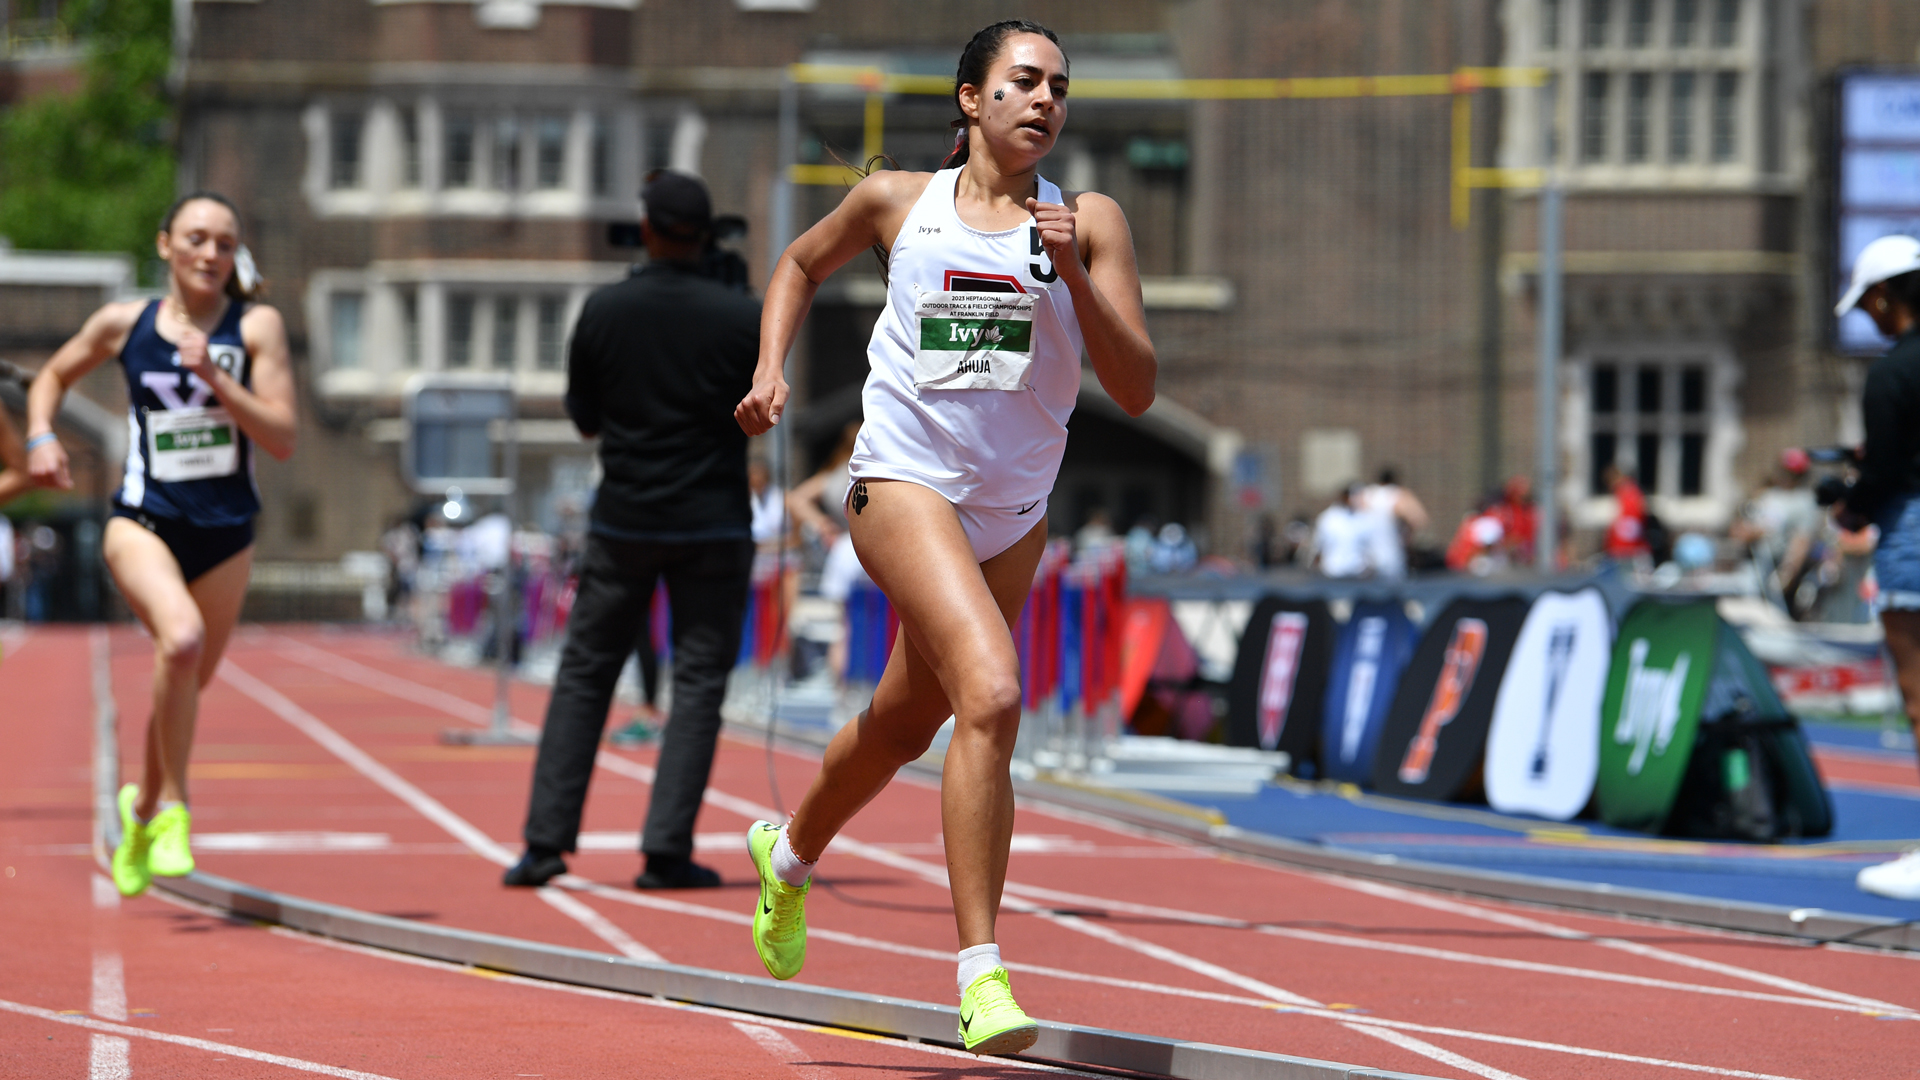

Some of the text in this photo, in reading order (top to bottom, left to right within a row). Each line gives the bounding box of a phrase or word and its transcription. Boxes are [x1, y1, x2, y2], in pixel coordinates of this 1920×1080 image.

[918, 225, 934, 236] Ivy
[1029, 226, 1058, 284] 5
[988, 303, 1032, 312] CHAMPIONSHIPS
[949, 323, 984, 347] Ivy
[957, 359, 991, 374] AHUJA
